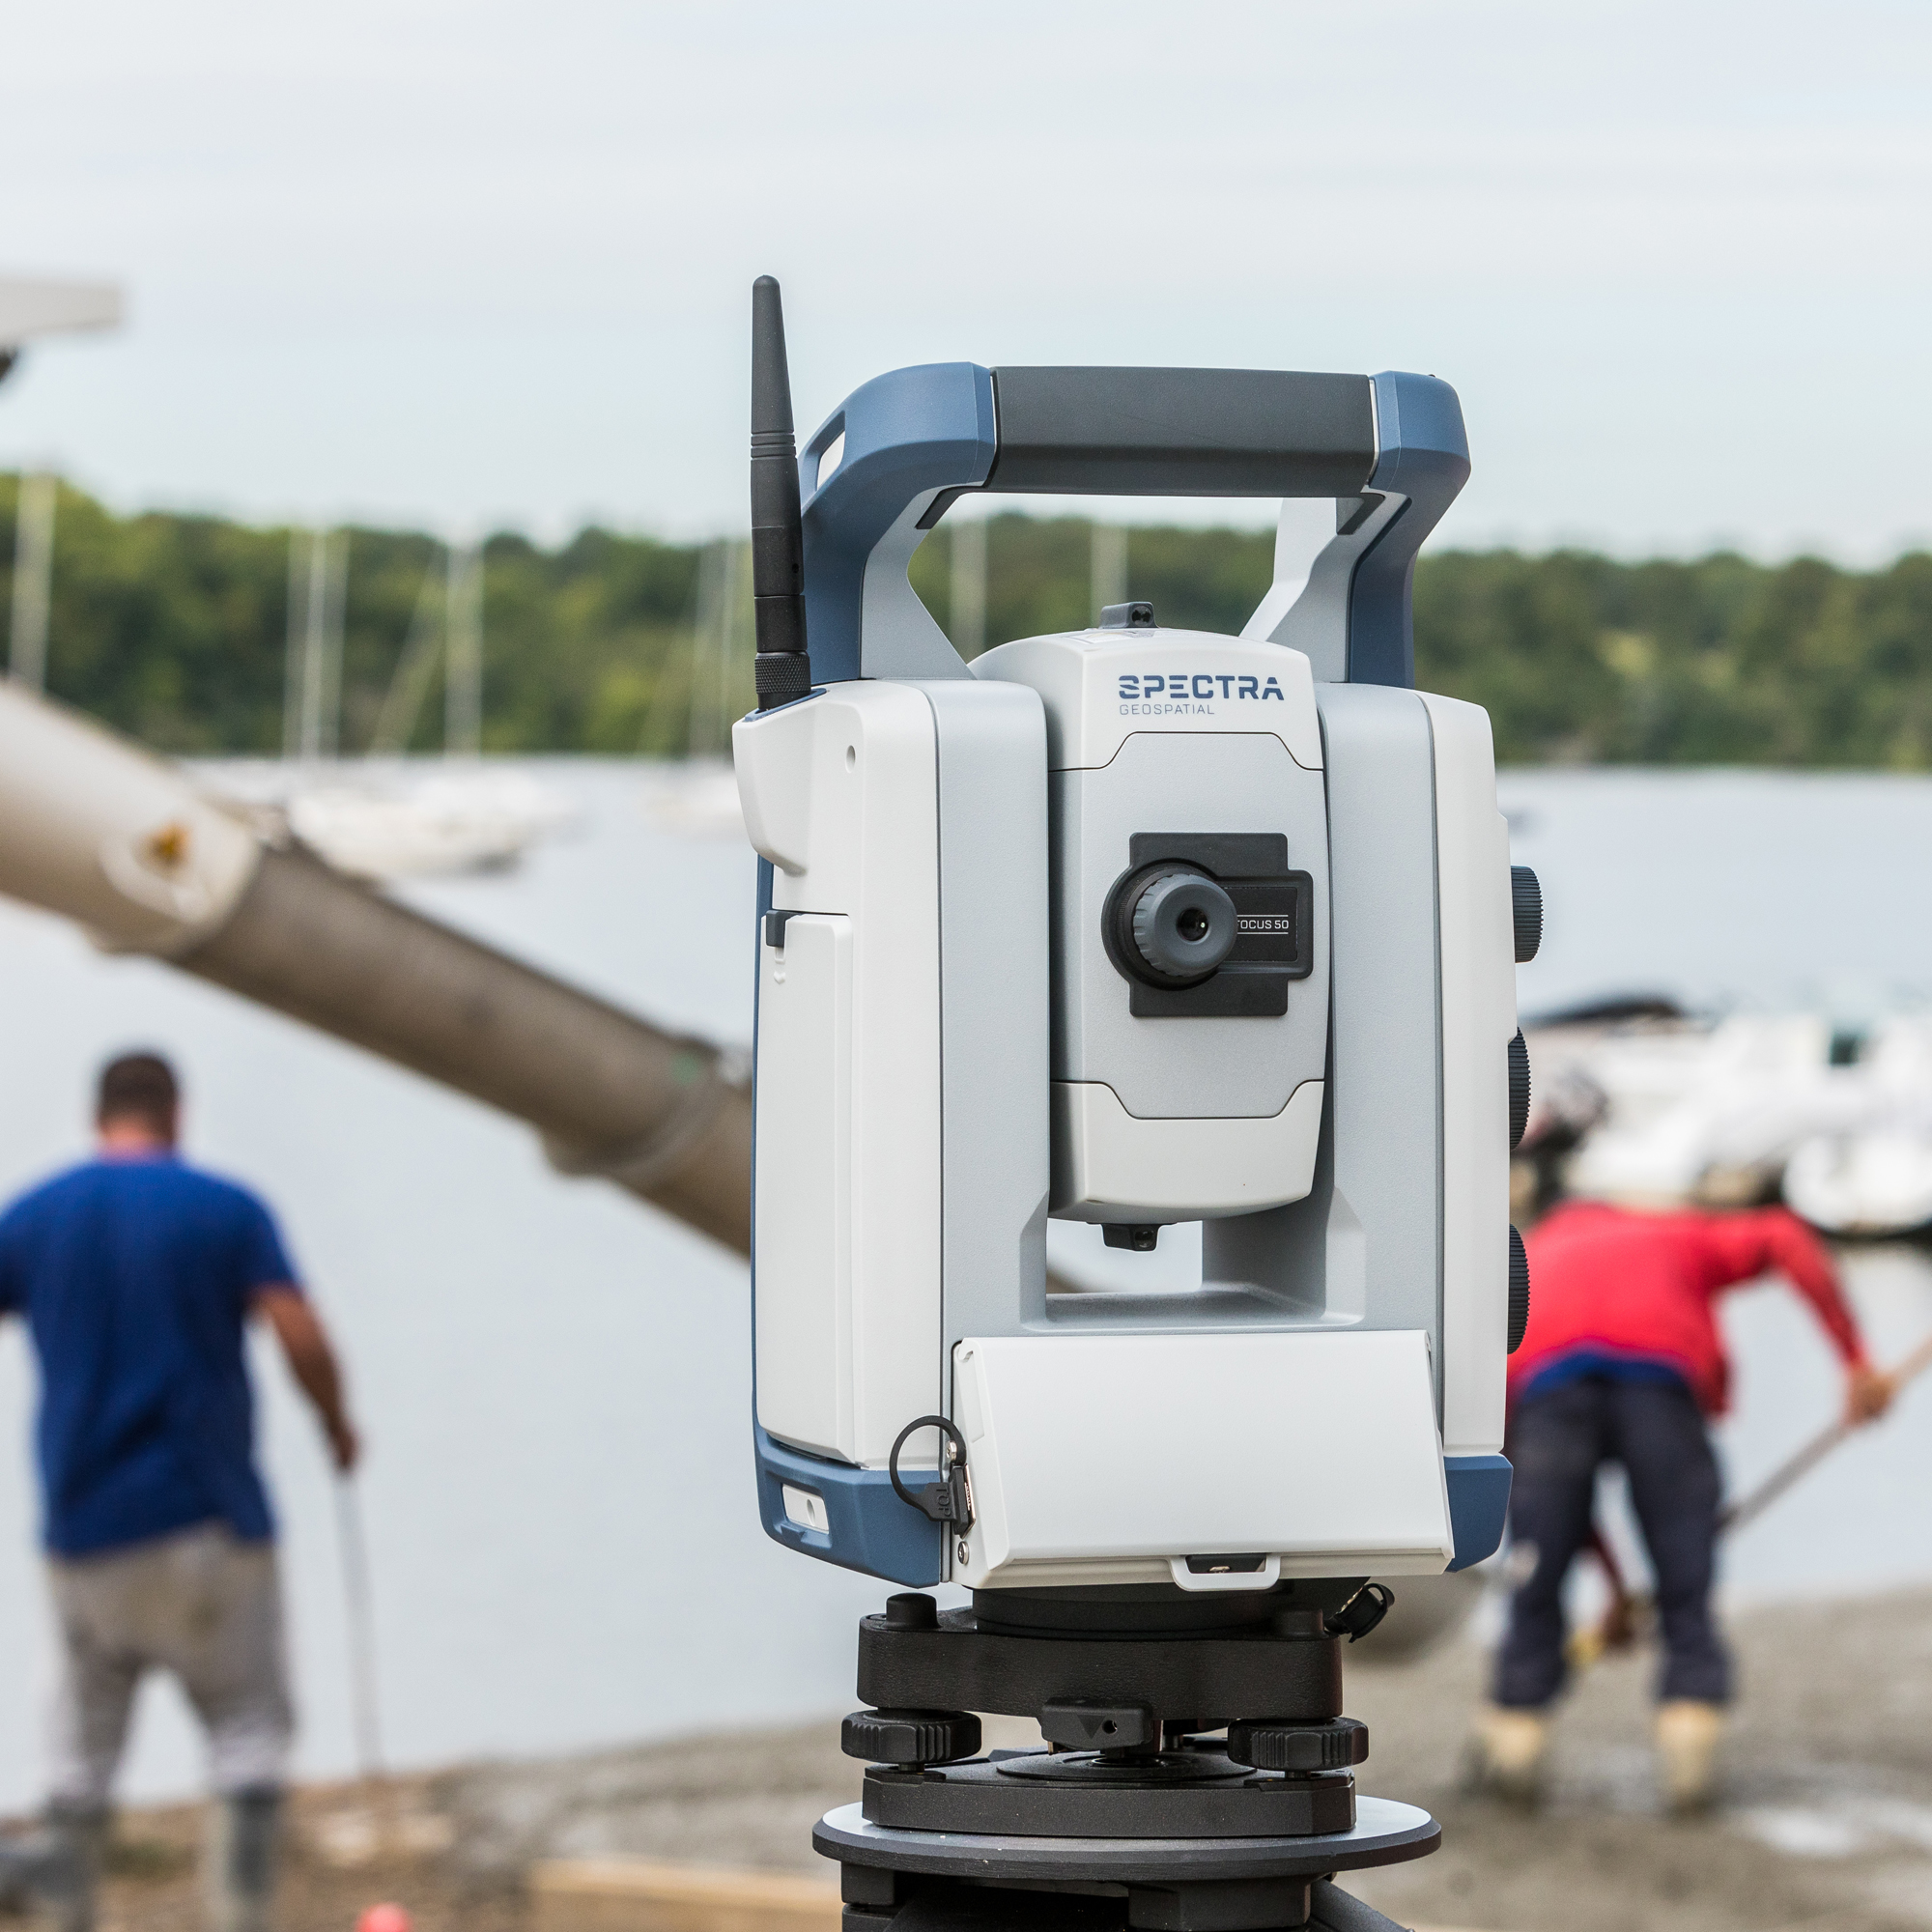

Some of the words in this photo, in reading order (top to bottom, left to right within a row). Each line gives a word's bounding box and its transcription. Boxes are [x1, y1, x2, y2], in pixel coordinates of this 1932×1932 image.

[1119, 674, 1285, 700] SPECTRA
[1120, 703, 1215, 715] GEOSPATIAL
[1274, 920, 1290, 929] 50
[936, 1485, 952, 1518] TOP
